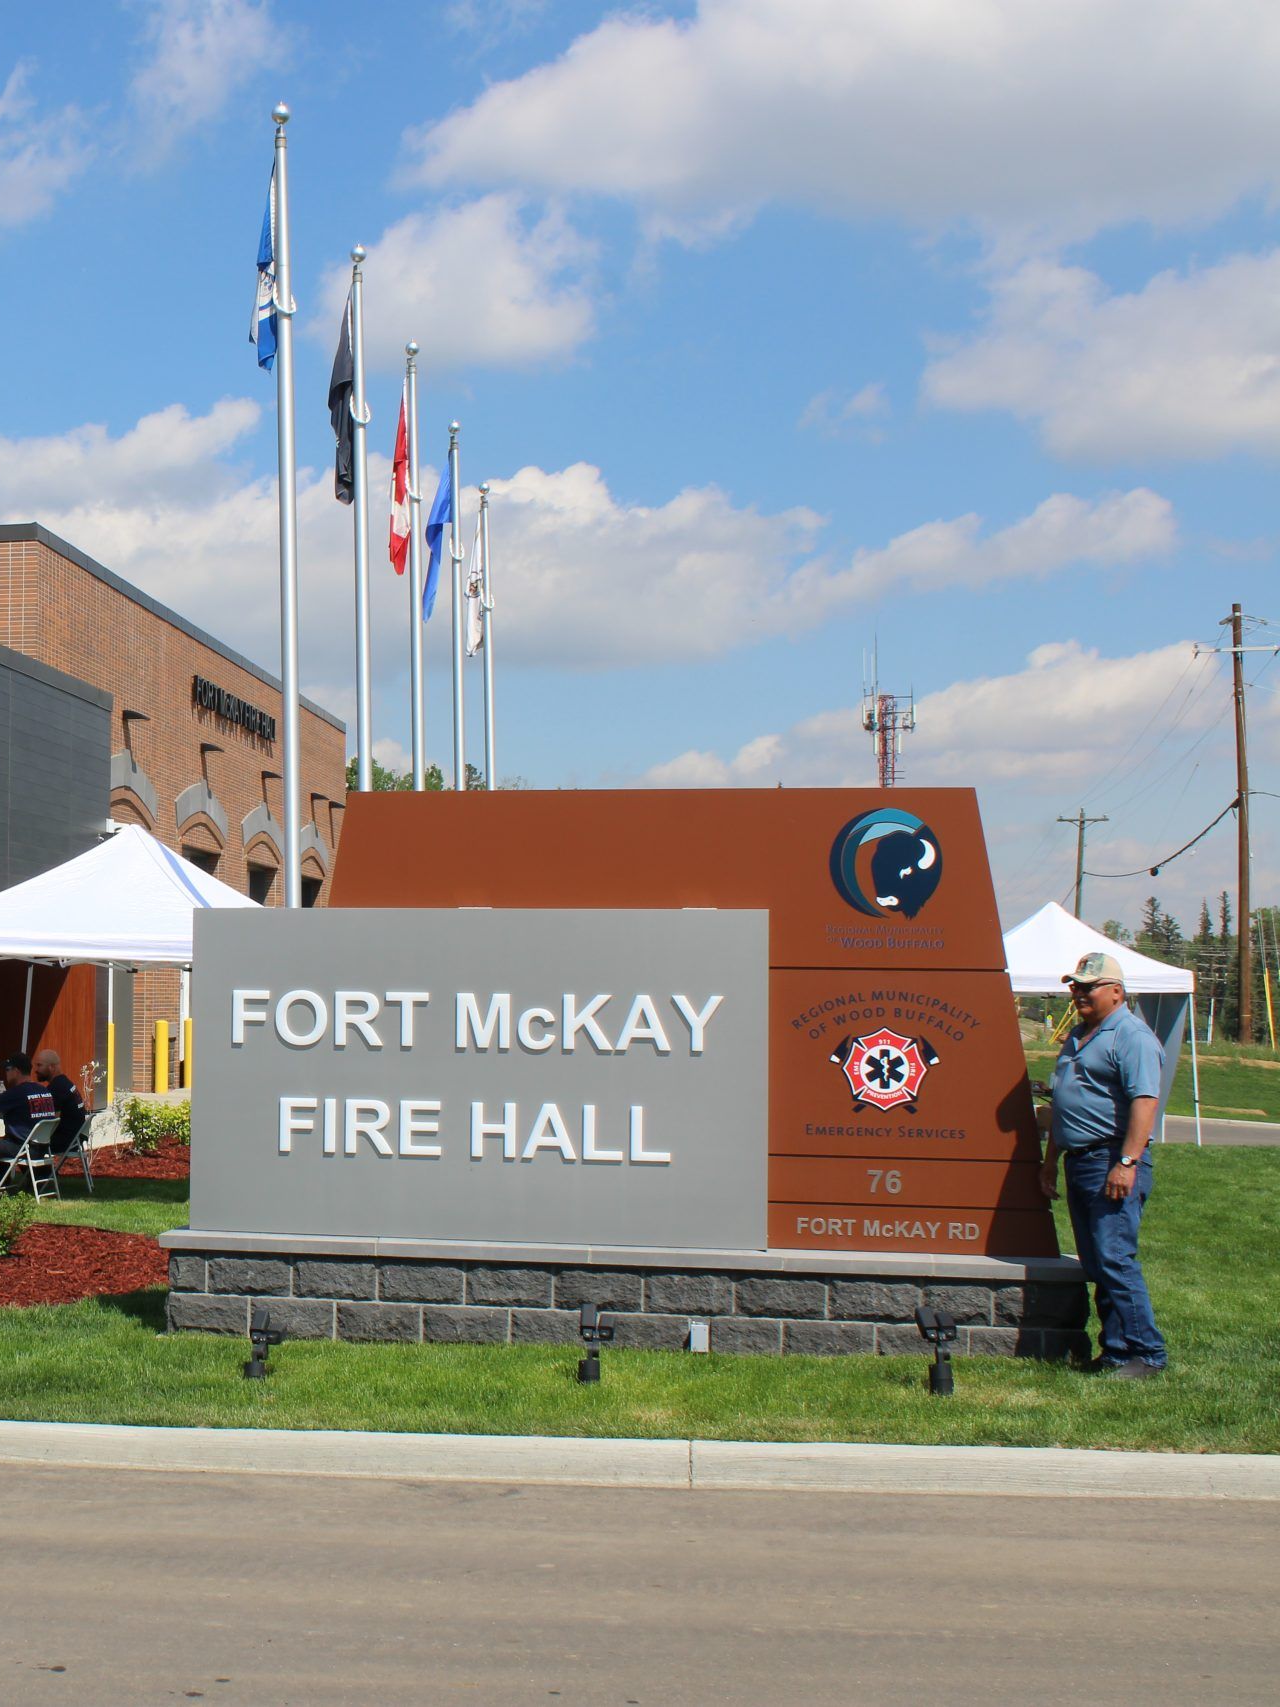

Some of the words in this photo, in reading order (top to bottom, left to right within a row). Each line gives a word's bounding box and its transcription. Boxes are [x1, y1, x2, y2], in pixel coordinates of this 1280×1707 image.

[194, 675, 218, 711] FORT
[232, 989, 430, 1048] FORT
[455, 992, 724, 1053] McKAY
[791, 992, 866, 1030] REGIONAL
[872, 990, 981, 1030] MUNICIPALITY
[809, 1023, 829, 1040] OF
[833, 1007, 886, 1027] WOOD
[894, 1007, 966, 1042] BUFFALO
[866, 1089, 903, 1100] PREVENTION
[278, 1097, 442, 1158] FIRE
[471, 1102, 671, 1164] HALL
[805, 1123, 892, 1138] EMERGENCY
[898, 1125, 966, 1140] SERVICES
[867, 1169, 902, 1194] 76
[796, 1217, 856, 1236] FORT
[863, 1219, 941, 1239] McKAY
[948, 1222, 980, 1240] RD
